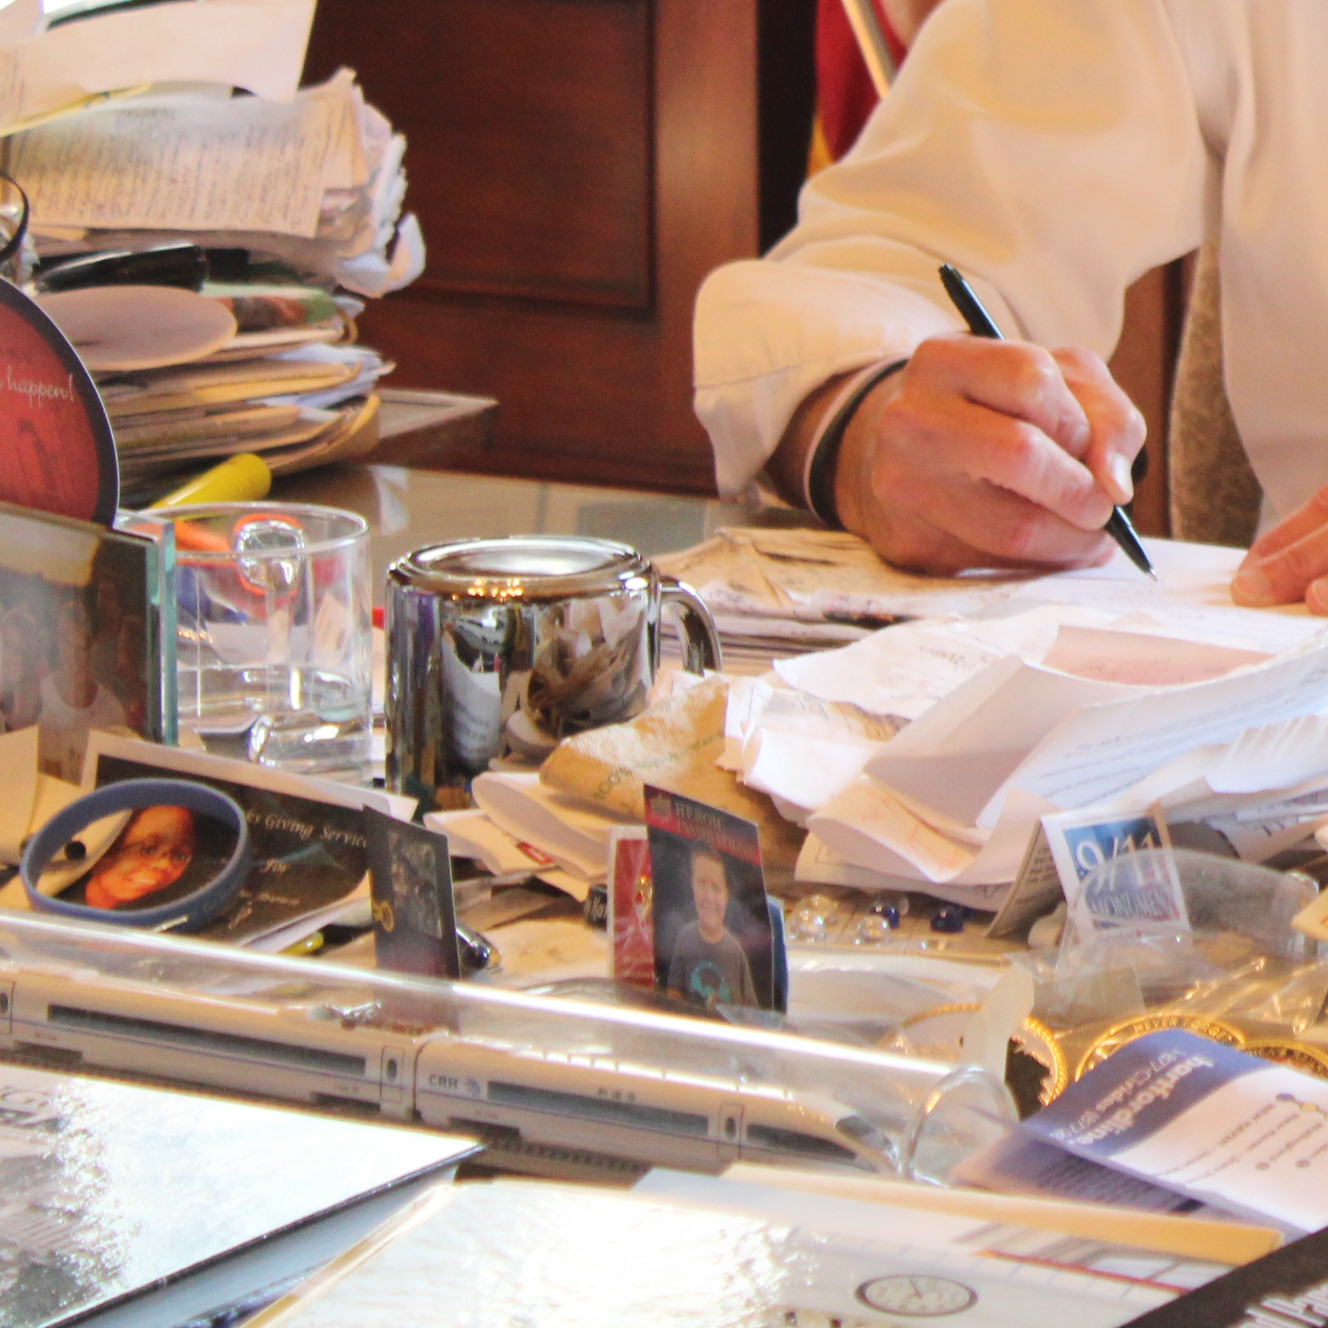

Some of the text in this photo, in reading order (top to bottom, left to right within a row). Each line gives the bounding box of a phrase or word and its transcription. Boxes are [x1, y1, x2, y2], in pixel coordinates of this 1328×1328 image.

[6, 363, 76, 407] happen!
[264, 814, 314, 842] Giving
[1076, 831, 1164, 896] 9/11
[428, 1073, 459, 1091] CRH
